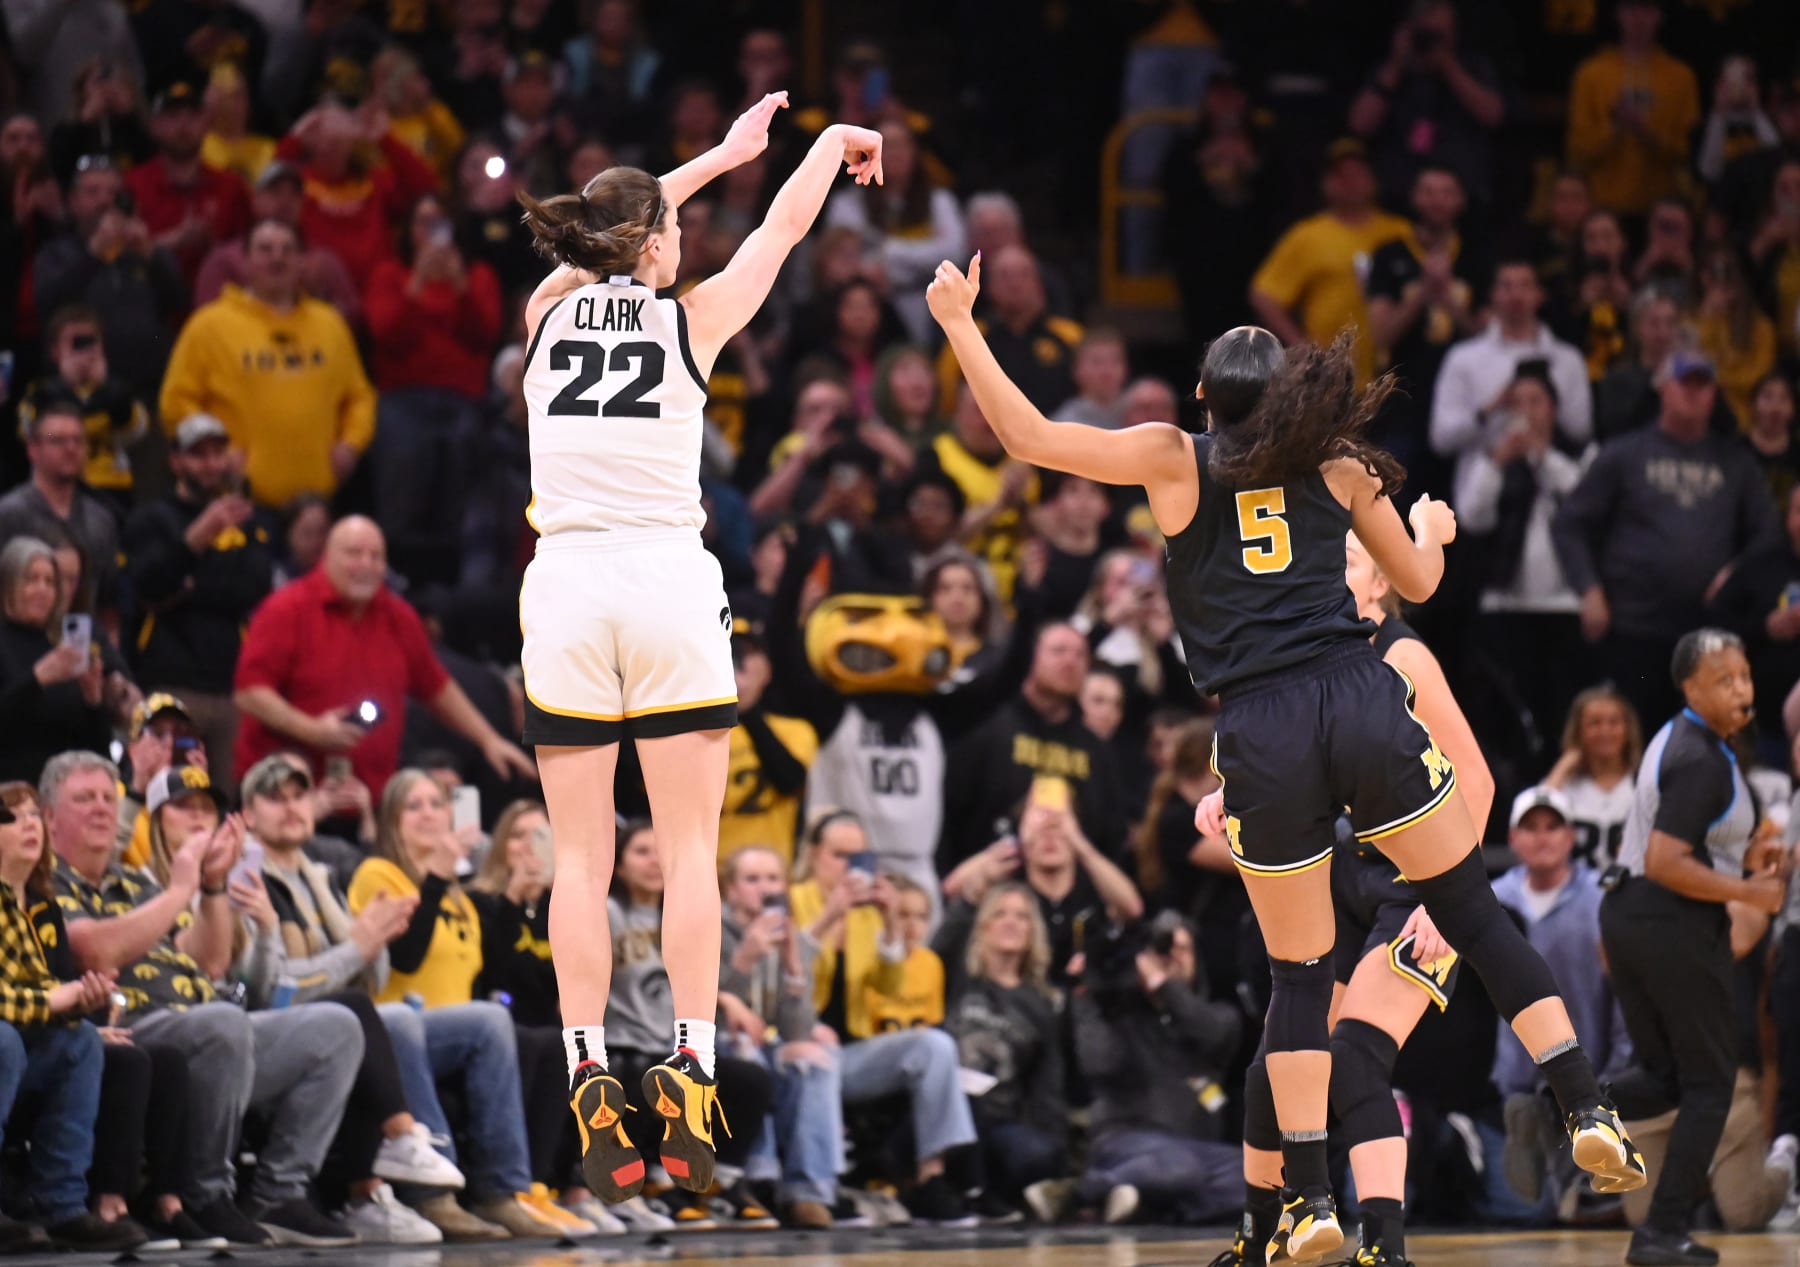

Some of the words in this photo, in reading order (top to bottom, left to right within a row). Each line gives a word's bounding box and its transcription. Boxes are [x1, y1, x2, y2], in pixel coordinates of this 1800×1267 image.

[575, 297, 645, 332] CLARK
[548, 339, 666, 418] 22
[1235, 487, 1293, 574] 5
